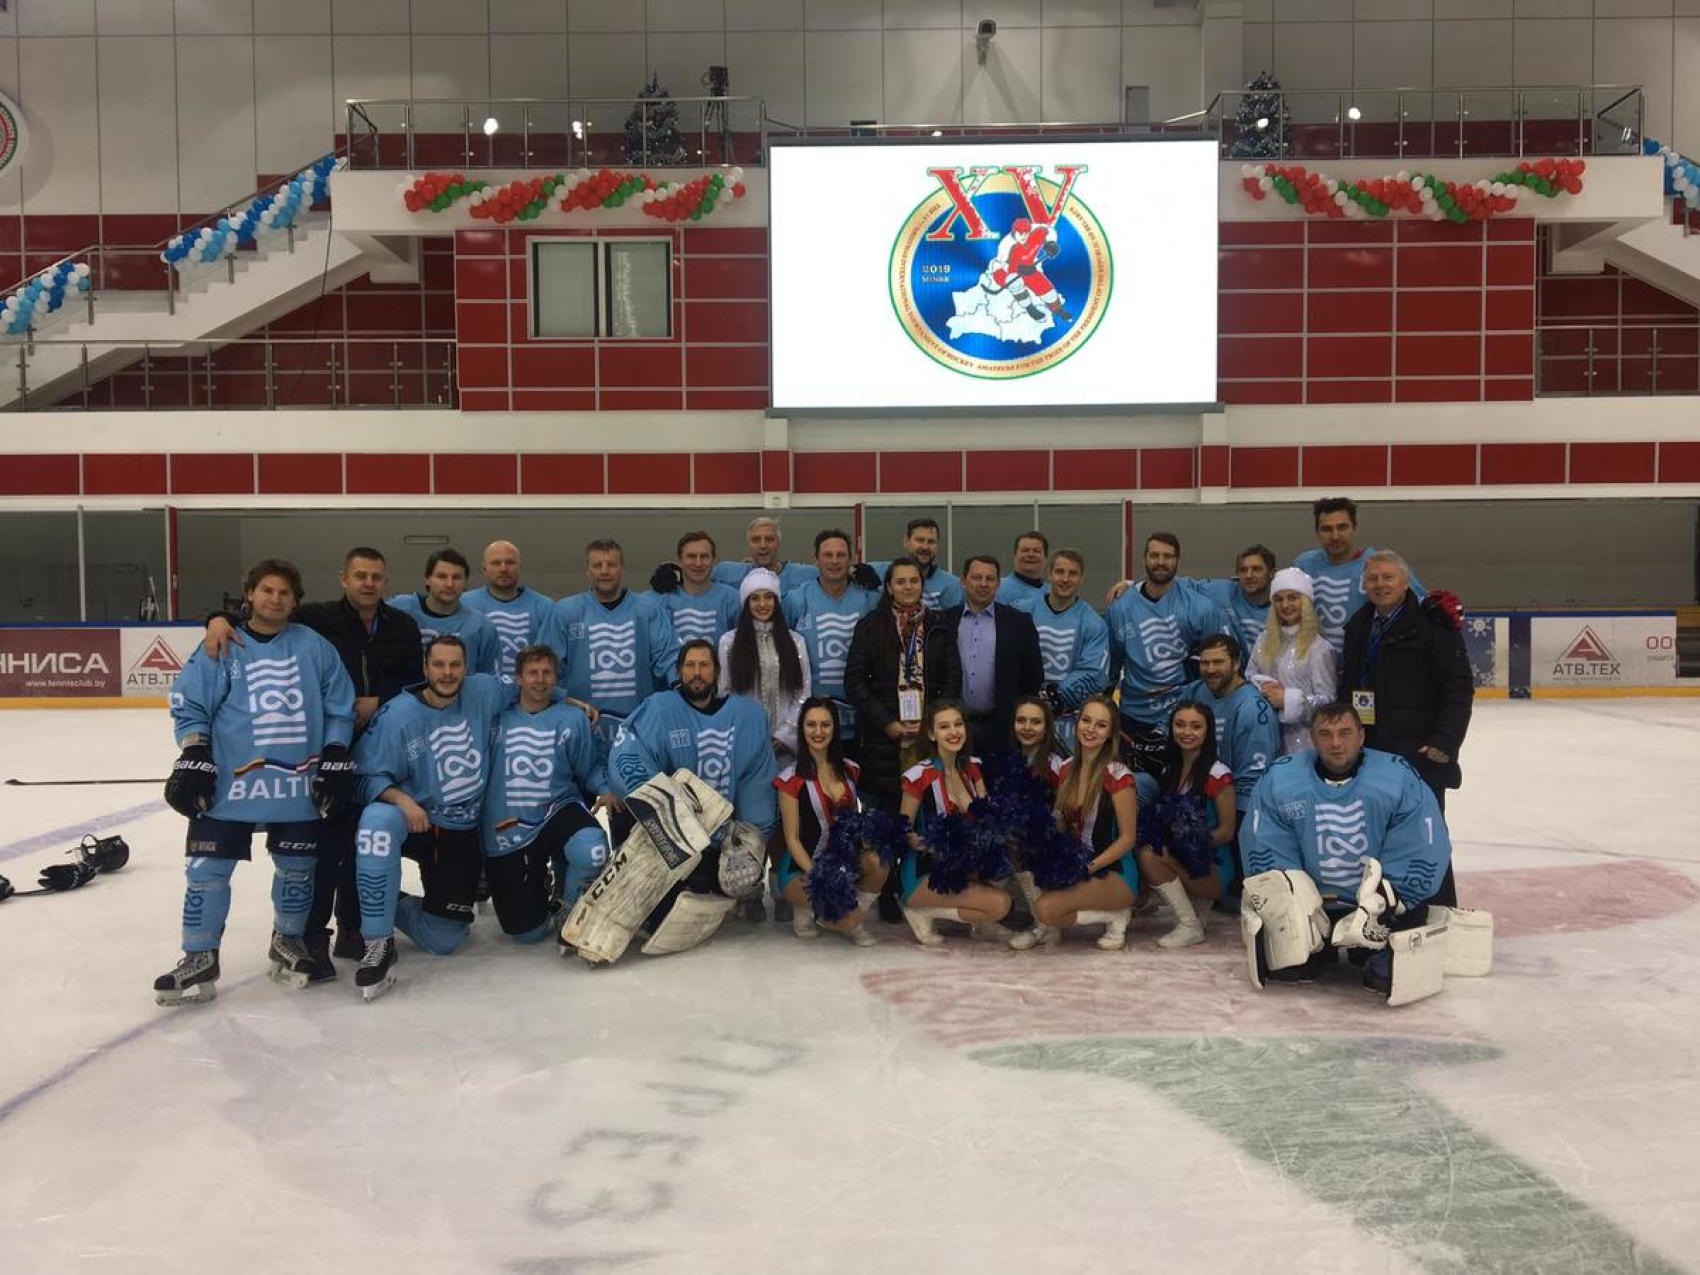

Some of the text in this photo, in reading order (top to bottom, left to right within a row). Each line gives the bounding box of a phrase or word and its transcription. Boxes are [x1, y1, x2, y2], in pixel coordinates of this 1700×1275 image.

[926, 164, 1089, 242] XV
[921, 264, 952, 274] 2019
[25, 679, 106, 688] www.tennisclub.by
[357, 829, 392, 857] 58
[1424, 817, 1434, 845] 1
[278, 841, 317, 850] CCM
[590, 844, 607, 867] 9
[591, 851, 628, 900] CCM
